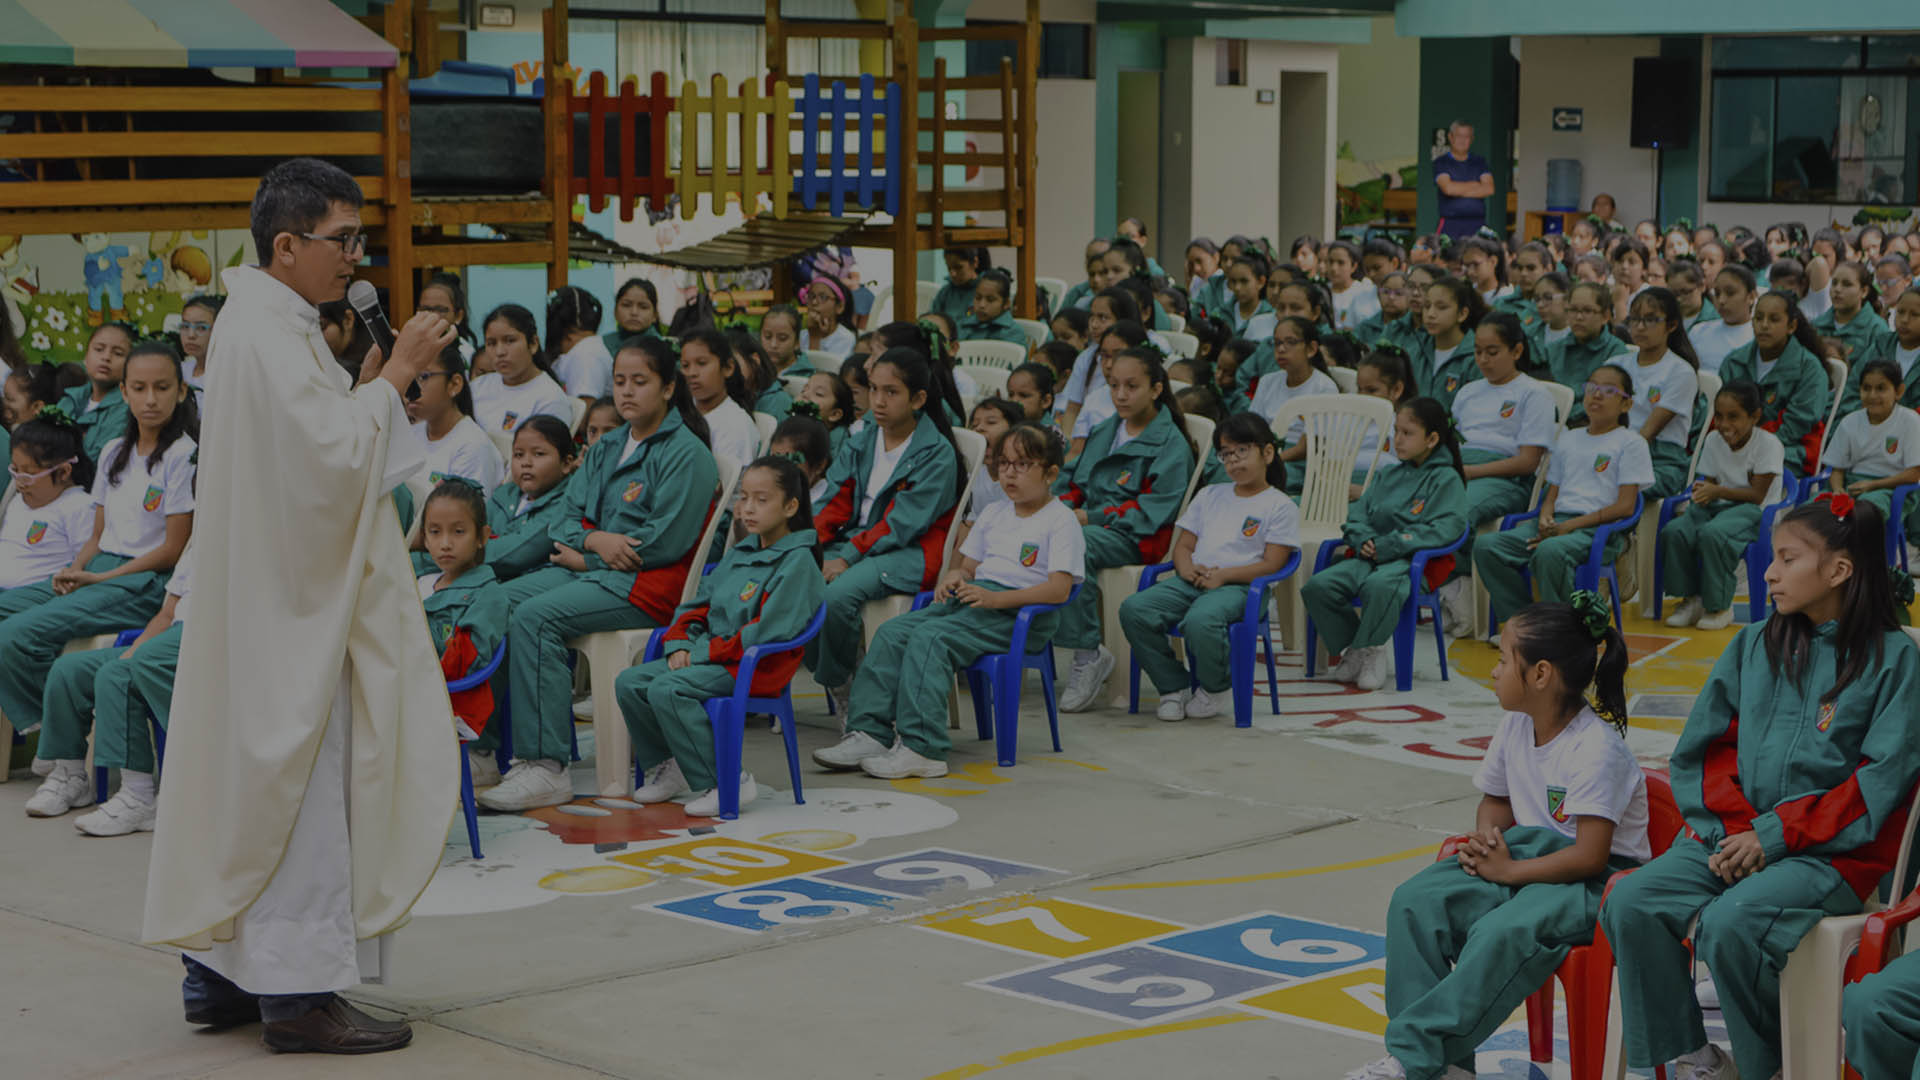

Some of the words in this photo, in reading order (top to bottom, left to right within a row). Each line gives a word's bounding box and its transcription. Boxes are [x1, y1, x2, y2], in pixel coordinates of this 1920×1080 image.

[647, 846, 790, 876] 10
[873, 861, 994, 890] 9
[713, 890, 868, 923] 8
[970, 906, 1092, 943] 7
[1240, 928, 1368, 963] 6
[1049, 963, 1215, 1007] 5
